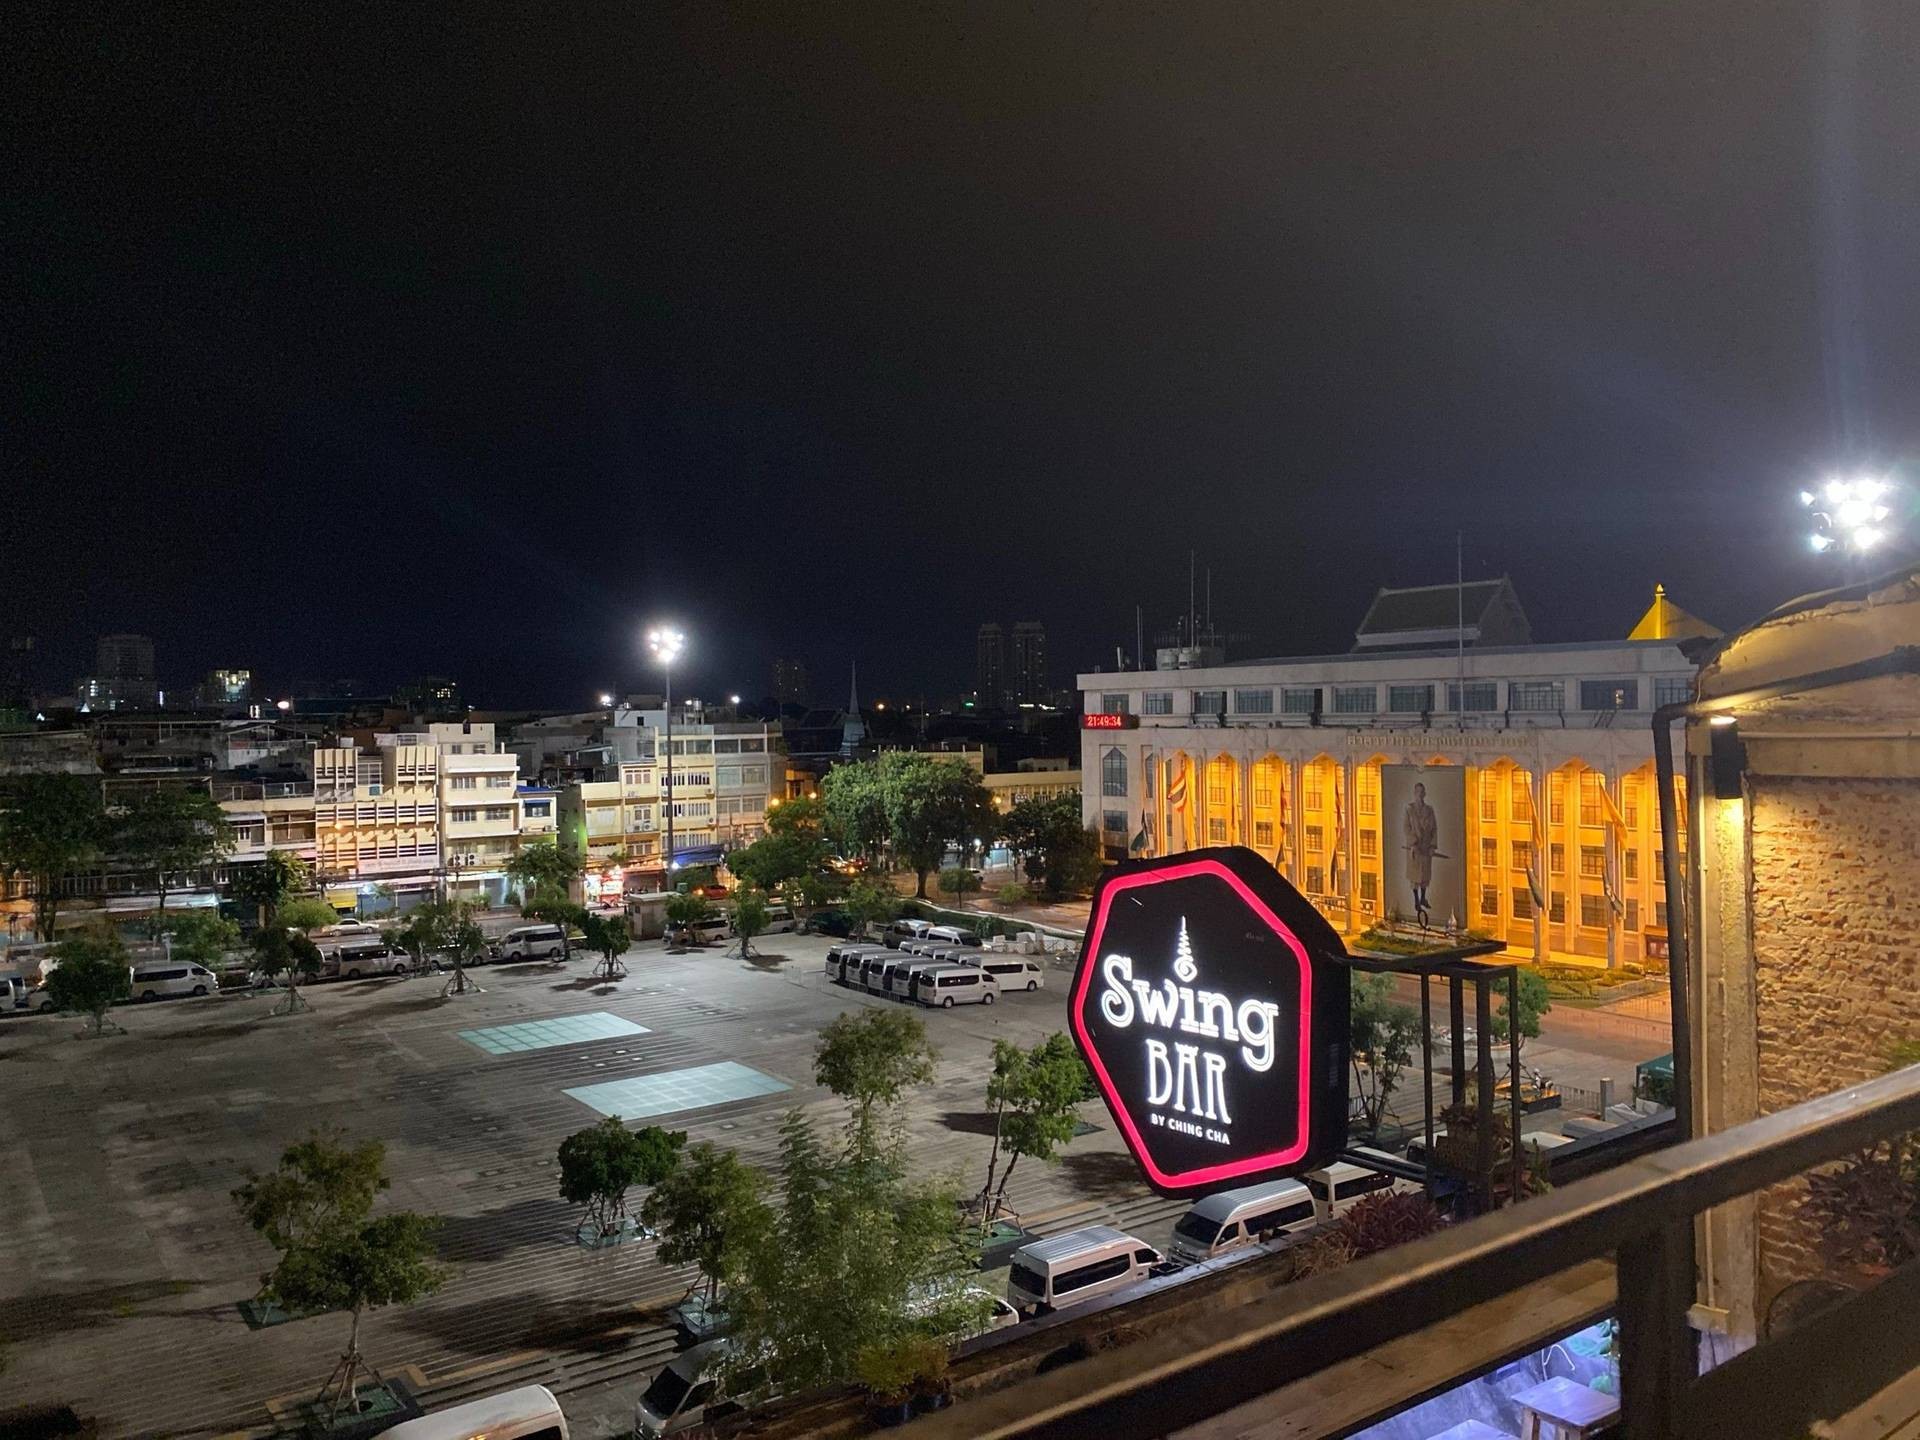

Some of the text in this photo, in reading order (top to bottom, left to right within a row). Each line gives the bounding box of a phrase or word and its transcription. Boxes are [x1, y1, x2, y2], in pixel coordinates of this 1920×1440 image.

[1087, 715, 1122, 727] 21:49:34
[1100, 953, 1279, 1073] Swing
[1144, 1037, 1233, 1125] BAR
[1150, 1113, 1231, 1145] BY CHING CHA
